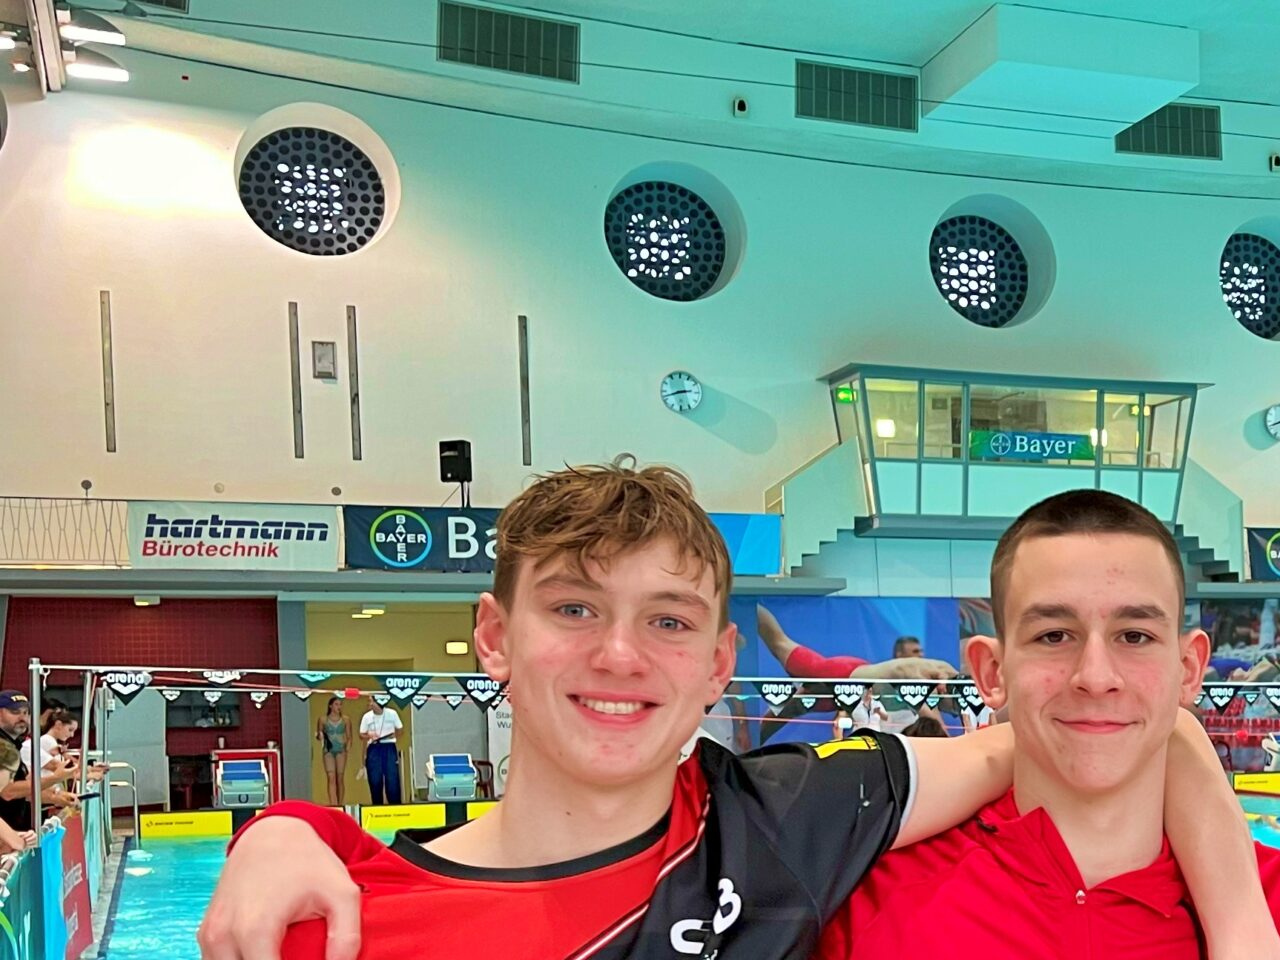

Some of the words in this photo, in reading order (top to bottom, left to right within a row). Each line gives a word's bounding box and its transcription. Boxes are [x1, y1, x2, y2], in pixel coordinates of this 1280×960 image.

[1014, 435, 1076, 457] Bayer
[144, 513, 329, 542] hartmann
[375, 532, 427, 544] BAYER
[447, 516, 498, 560] Ba
[142, 540, 280, 558] Bürotechnik
[106, 672, 145, 684] arena
[386, 677, 420, 688] arena
[466, 679, 501, 691] arena
[762, 683, 792, 694] arena
[834, 684, 864, 695] arena
[900, 685, 928, 695] arena
[963, 686, 979, 696] are
[1210, 688, 1234, 697] arena
[495, 710, 513, 720] Sta
[497, 720, 512, 729] Wu
